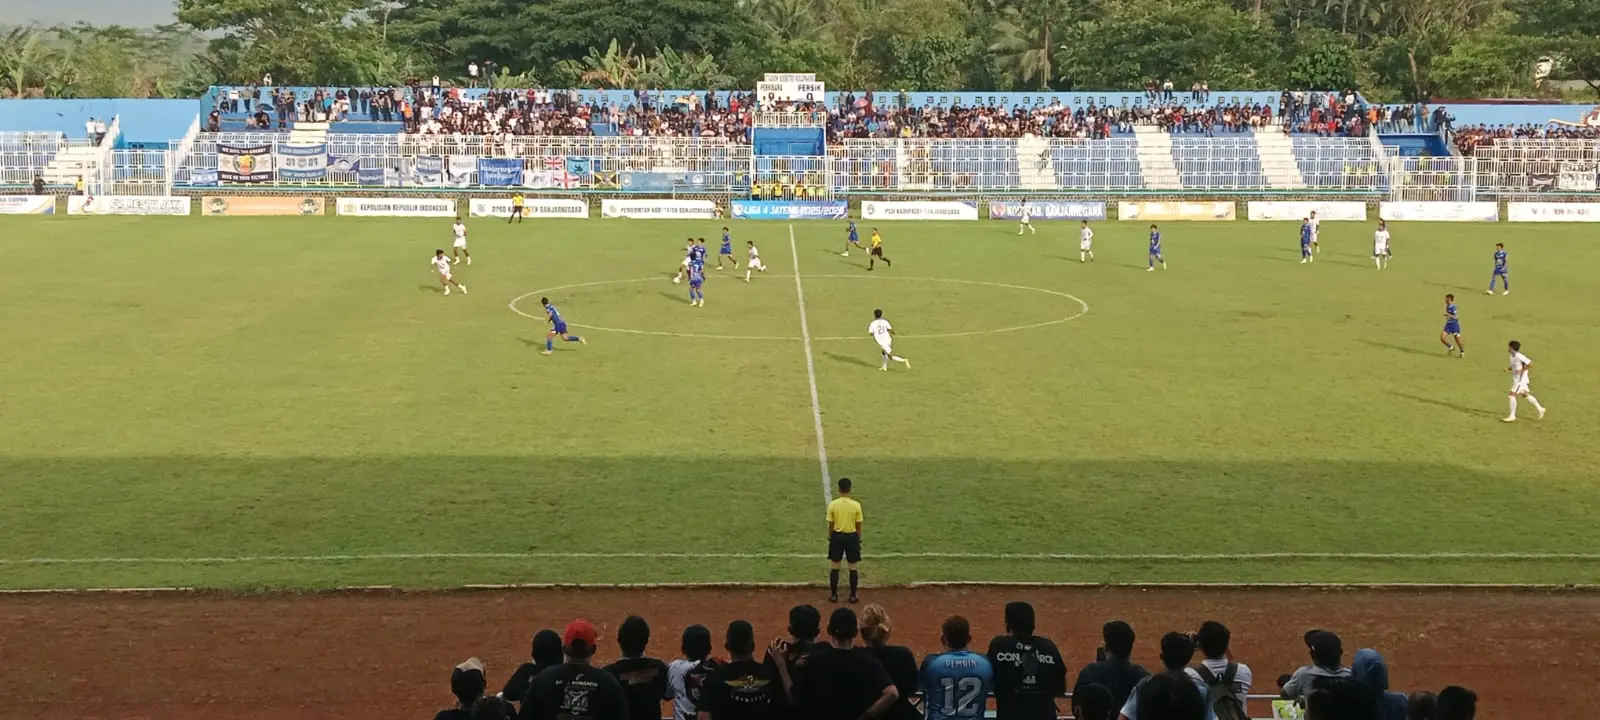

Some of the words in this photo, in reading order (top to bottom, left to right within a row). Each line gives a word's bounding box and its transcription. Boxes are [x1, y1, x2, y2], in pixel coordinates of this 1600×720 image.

[797, 84, 822, 92] PERSIK
[392, 204, 418, 212] REPUBLIK
[419, 204, 448, 212] INDONESIA
[743, 206, 761, 215] LIGA
[762, 206, 769, 215] 4
[771, 206, 799, 215] JATENG
[1045, 206, 1103, 218] BANJARNEGARA
[940, 677, 982, 717] 12
